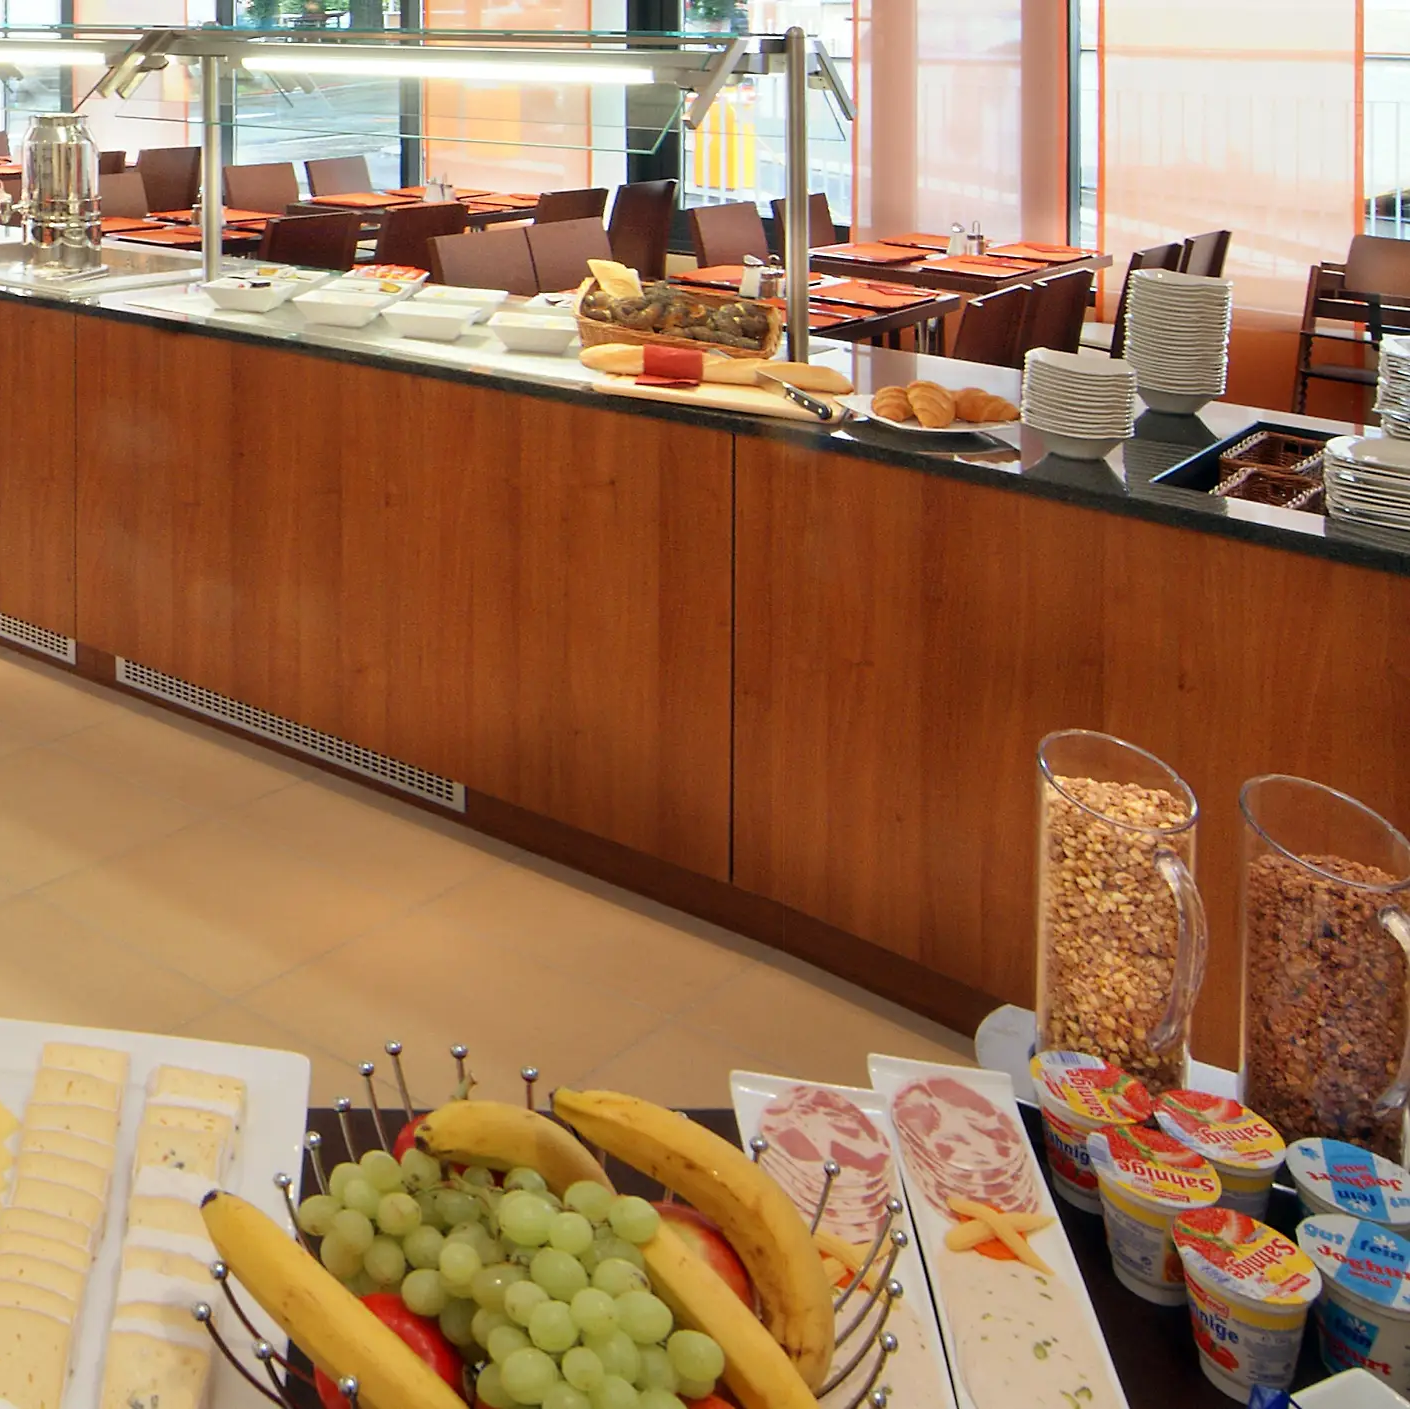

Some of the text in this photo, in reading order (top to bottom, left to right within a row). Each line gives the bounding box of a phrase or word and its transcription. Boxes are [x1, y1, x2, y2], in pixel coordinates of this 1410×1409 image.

[1195, 1123, 1274, 1145] Sahnige
[1118, 1158, 1215, 1193] Sahnige
[1306, 1171, 1403, 1192] Joghurt
[1337, 1190, 1377, 1206] fein
[1304, 1223, 1405, 1262] gut fein
[1225, 1237, 1297, 1280] Sahnige
